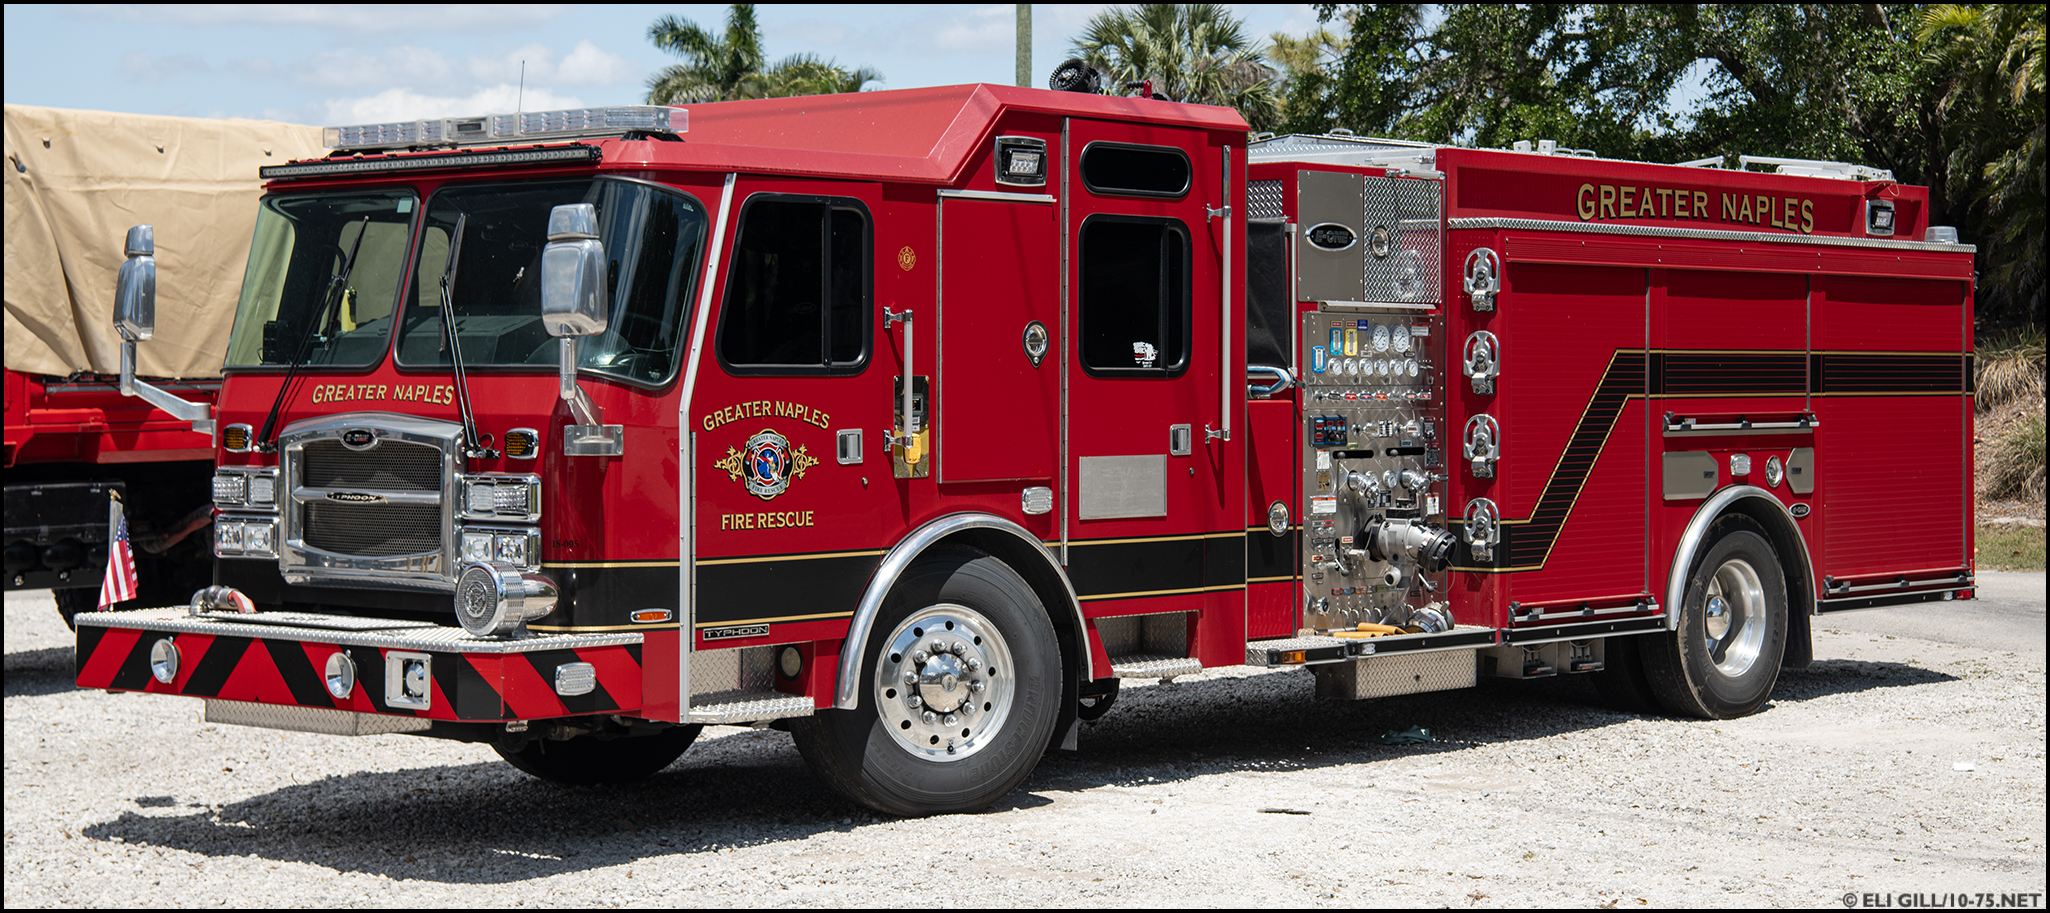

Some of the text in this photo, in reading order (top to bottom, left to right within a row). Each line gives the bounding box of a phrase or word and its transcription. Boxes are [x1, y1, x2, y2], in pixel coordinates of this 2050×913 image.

[1577, 183, 1814, 234] GREATER NAPLES
[312, 384, 454, 405] GREATER NAPLES
[703, 401, 830, 432] GREATER NAPLES
[750, 435, 785, 446] GREATER NAPLES
[751, 484, 783, 493] FIRE RESCUE
[721, 510, 814, 531] FIRE RESCUE
[552, 540, 579, 548] 18-005
[705, 626, 767, 637] TYPHOON
